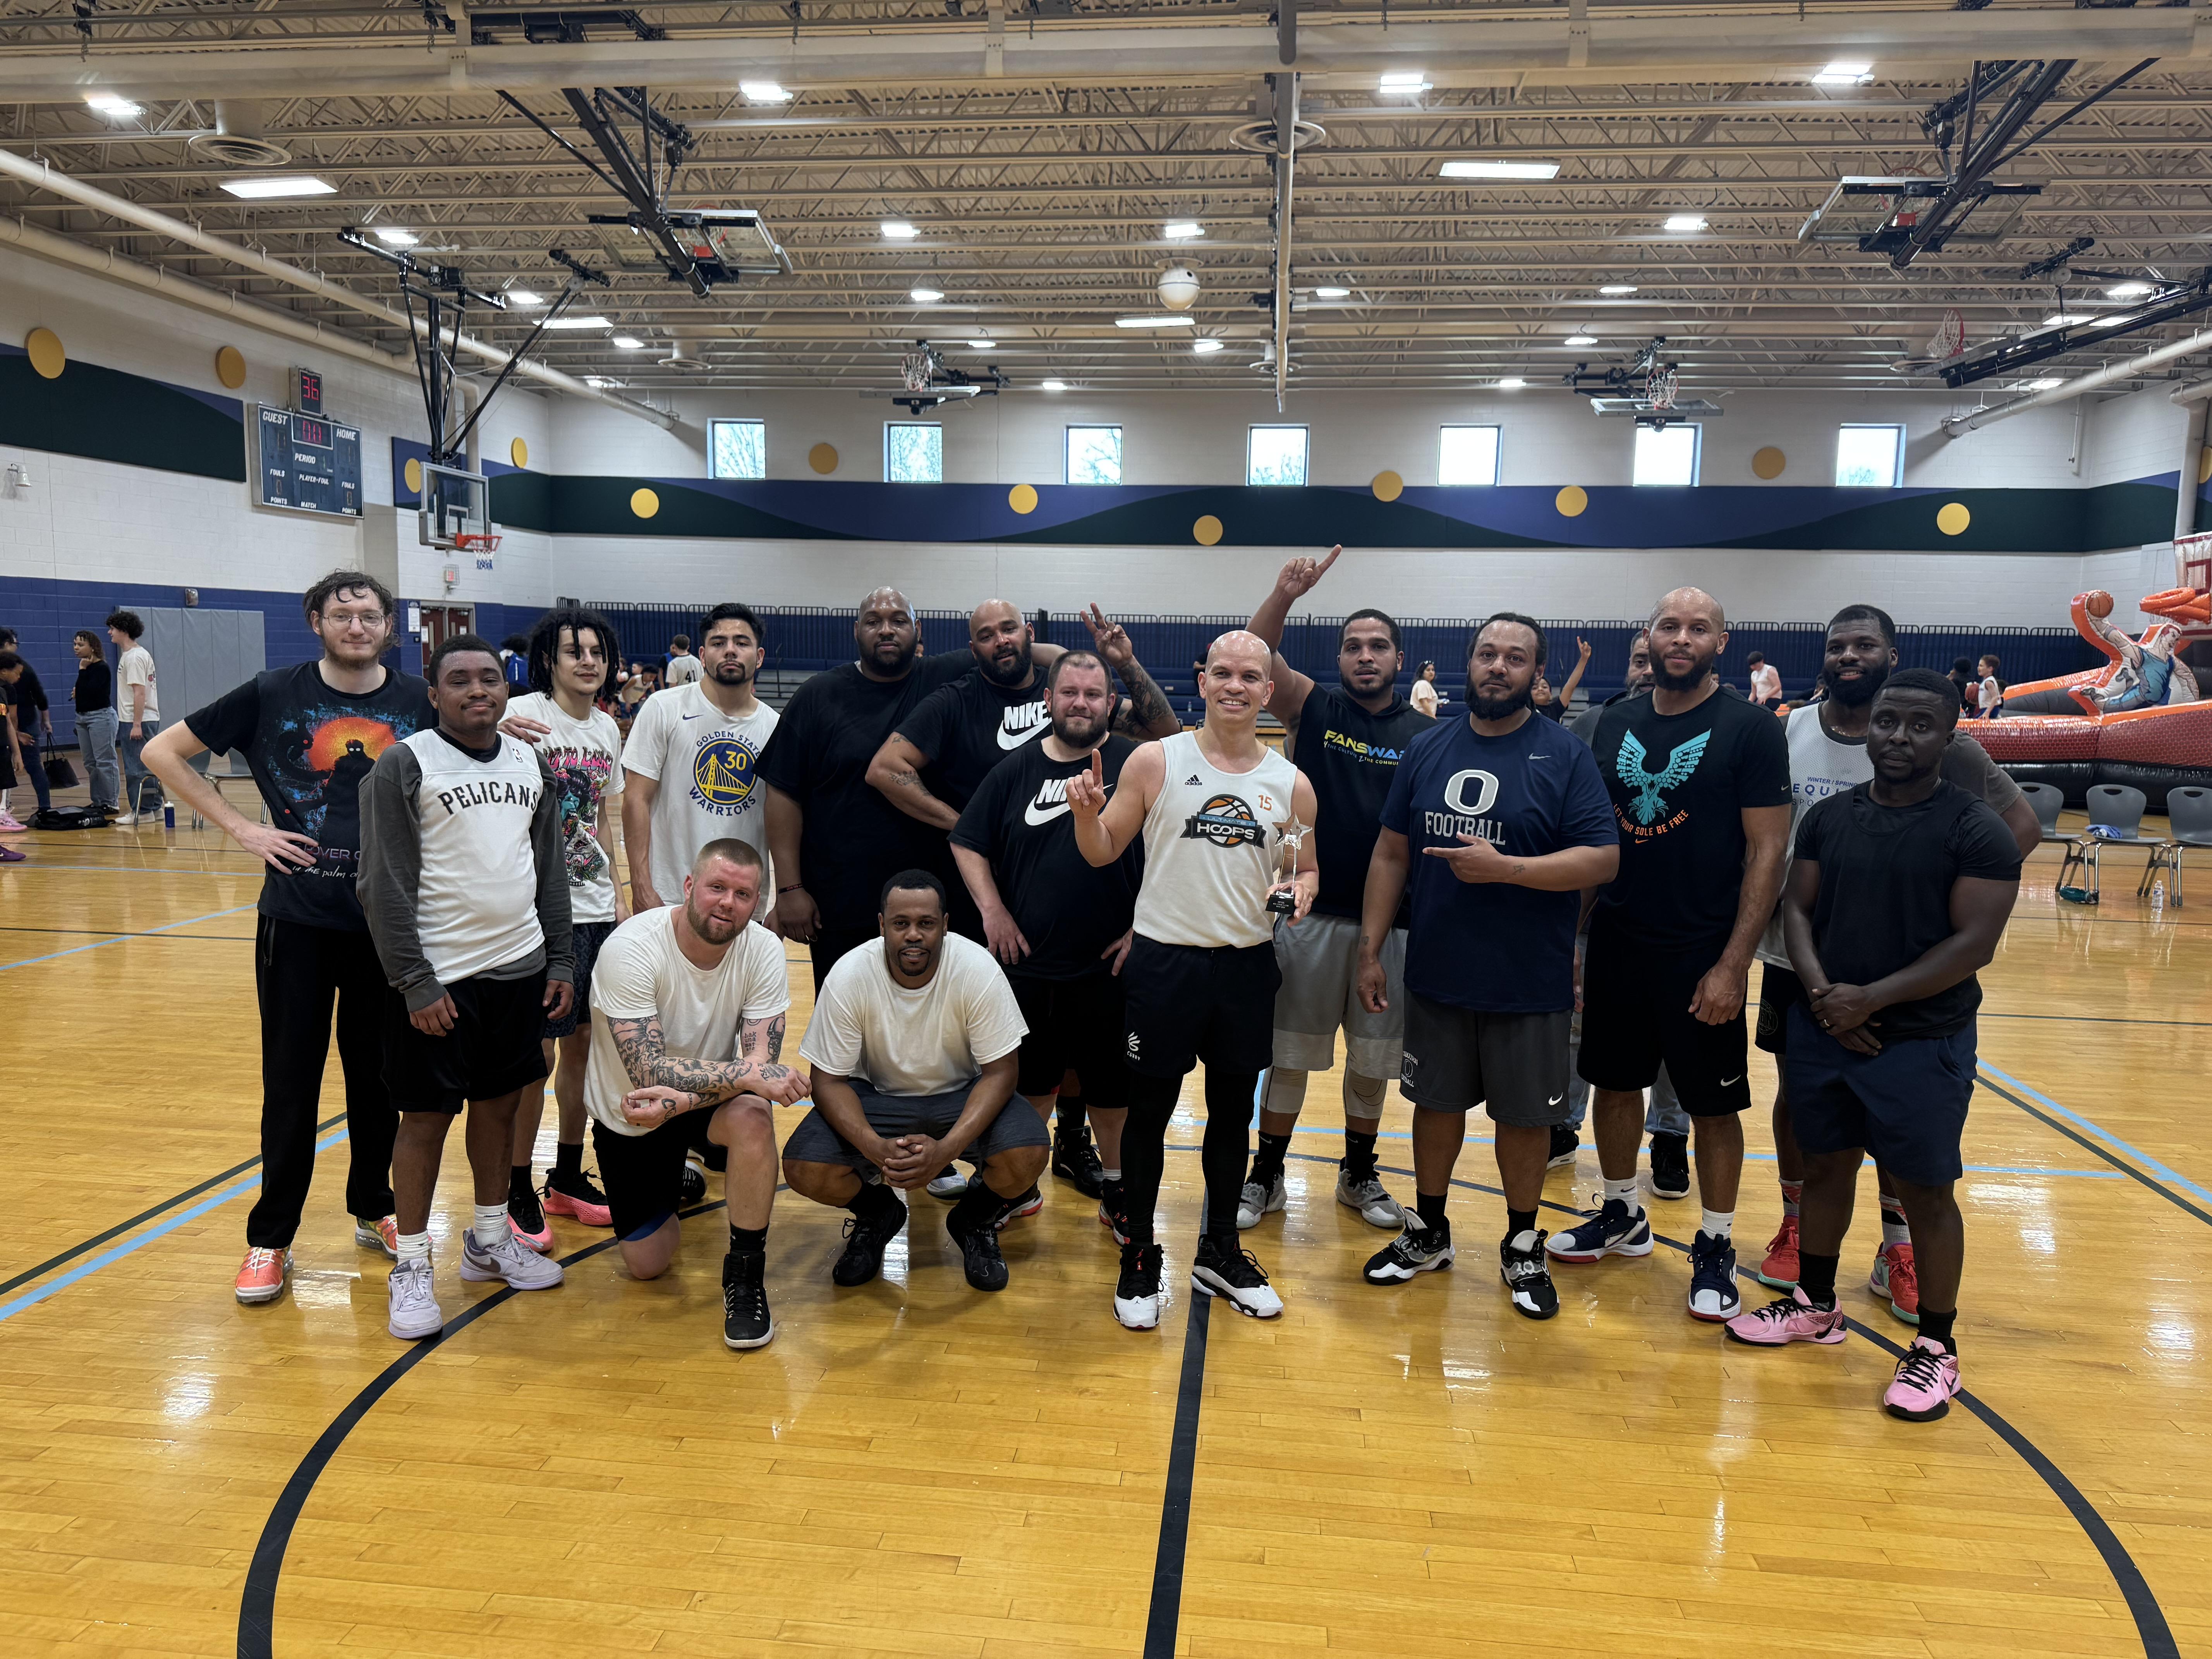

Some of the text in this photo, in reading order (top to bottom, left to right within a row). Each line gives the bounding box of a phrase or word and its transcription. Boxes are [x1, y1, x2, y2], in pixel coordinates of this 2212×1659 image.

[302, 375, 319, 401] 36
[263, 410, 288, 425] GUEST
[336, 428, 356, 441] HOME
[294, 452, 316, 464] PERIOD
[270, 468, 285, 477] FOULS
[341, 481, 355, 489] FOULS
[270, 496, 287, 505] POINTS
[685, 670, 696, 683] 41
[1004, 700, 1048, 730] NIKE
[697, 731, 734, 747] GOLDEN
[725, 751, 747, 771] 30
[1807, 776, 1831, 785] WINTER
[438, 781, 538, 815] PELICANS
[1444, 769, 1499, 815] O
[689, 786, 756, 816] WARRIORS
[1258, 794, 1273, 811] 15
[1207, 817, 1247, 826] ULTIMATE
[1613, 804, 1689, 836] LET YOUR SOLE BE FREE
[1197, 822, 1256, 840] HOOPS
[1425, 811, 1506, 845] FOOTBALL
[322, 865, 346, 879] palm
[1127, 1051, 1140, 1061] CURRY
